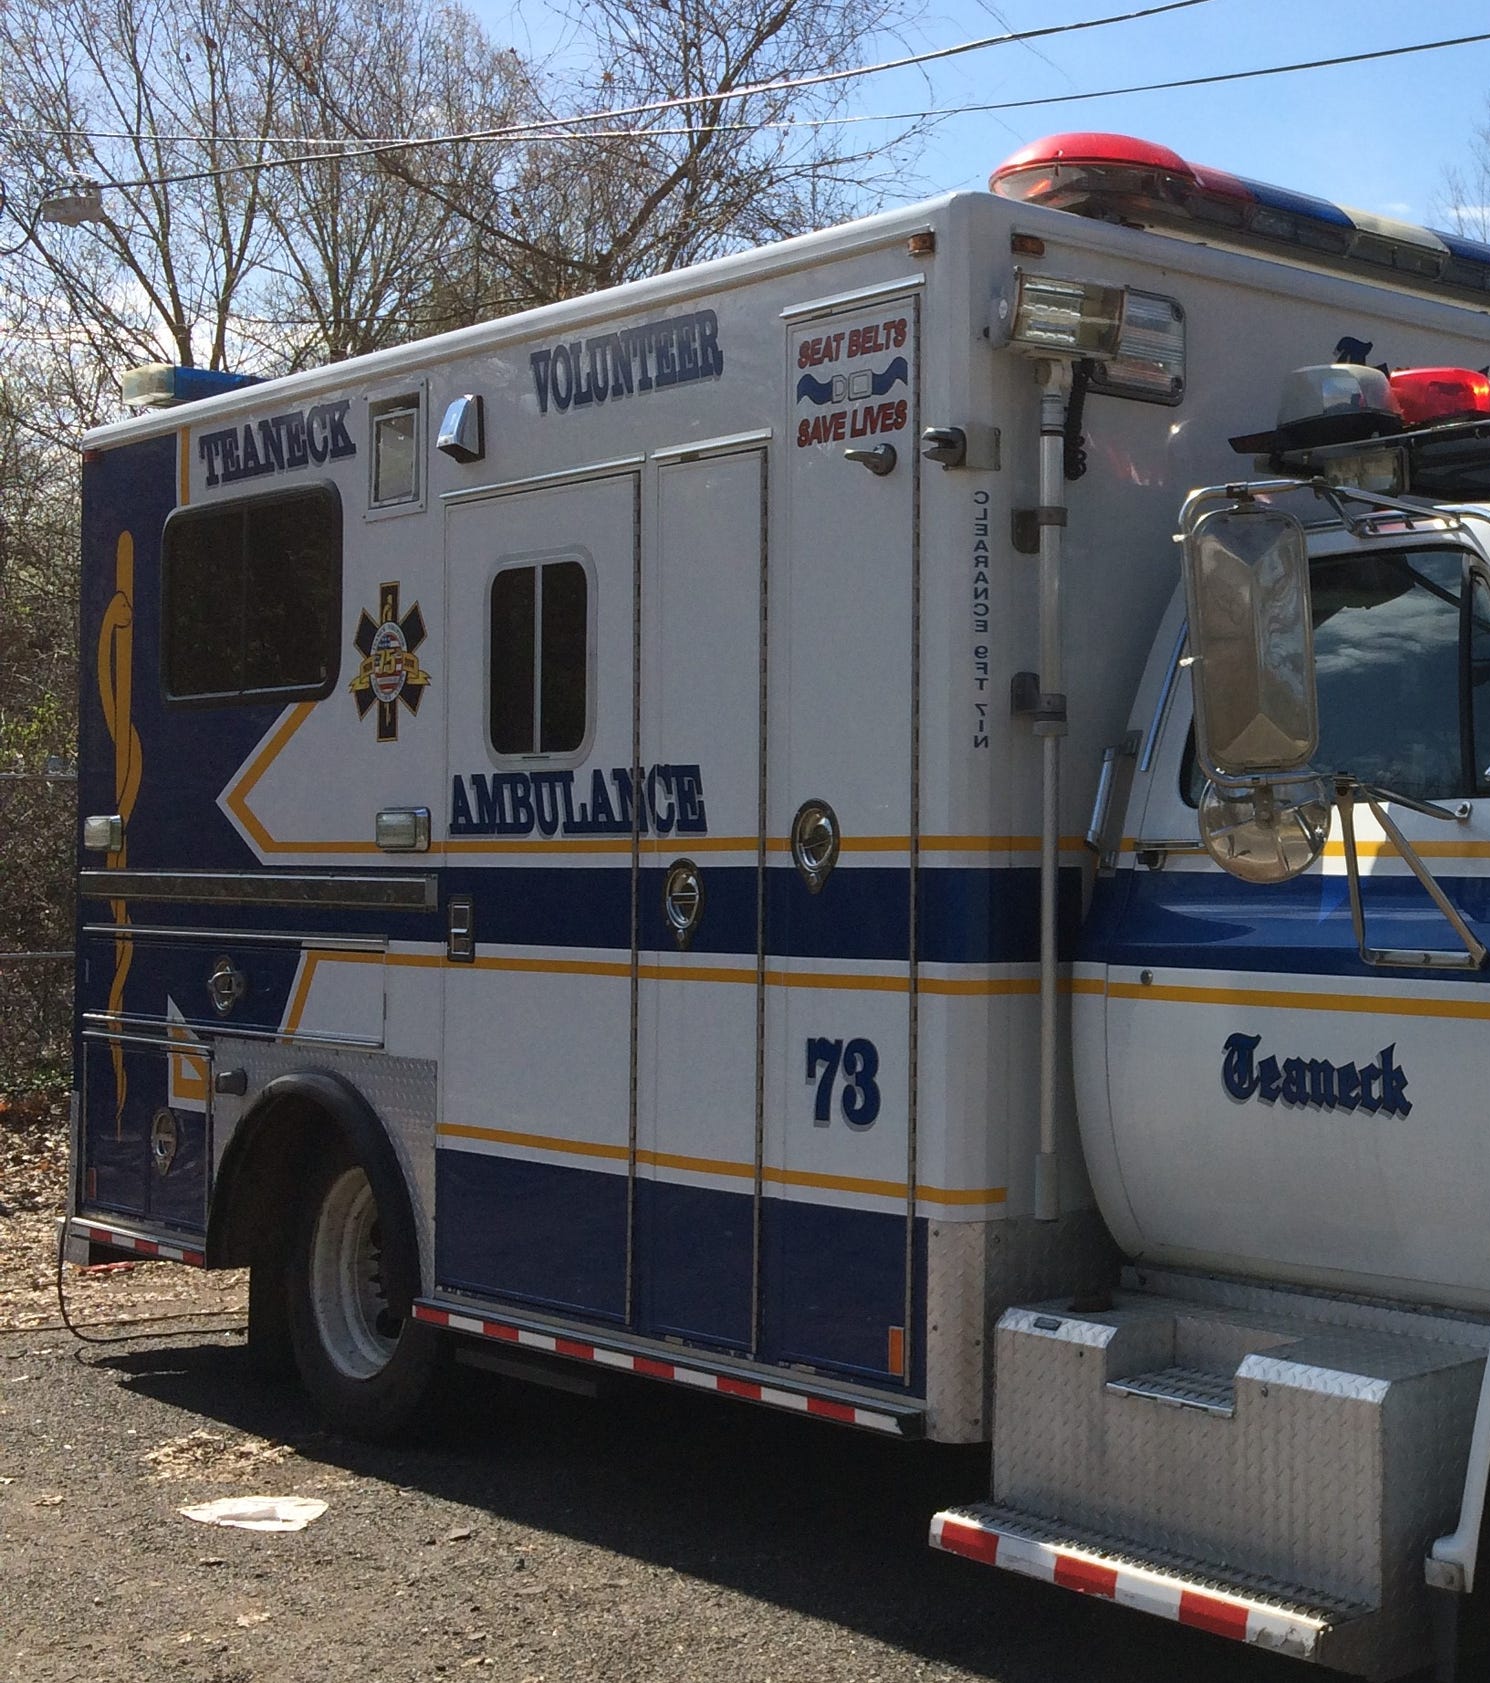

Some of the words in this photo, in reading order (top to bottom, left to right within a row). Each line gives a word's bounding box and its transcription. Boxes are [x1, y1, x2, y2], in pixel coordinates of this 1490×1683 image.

[530, 309, 724, 415] VOLUNTEER
[797, 332, 845, 369] SEAT
[847, 318, 908, 358] BELTS
[199, 400, 357, 488] TEANECK
[797, 411, 847, 448] SAVE
[850, 400, 908, 438] LIVES
[375, 648, 396, 675] 75
[449, 764, 708, 837] AMBULANCE
[805, 1037, 881, 1131] 73
[1222, 1032, 1413, 1120] Teaneck
